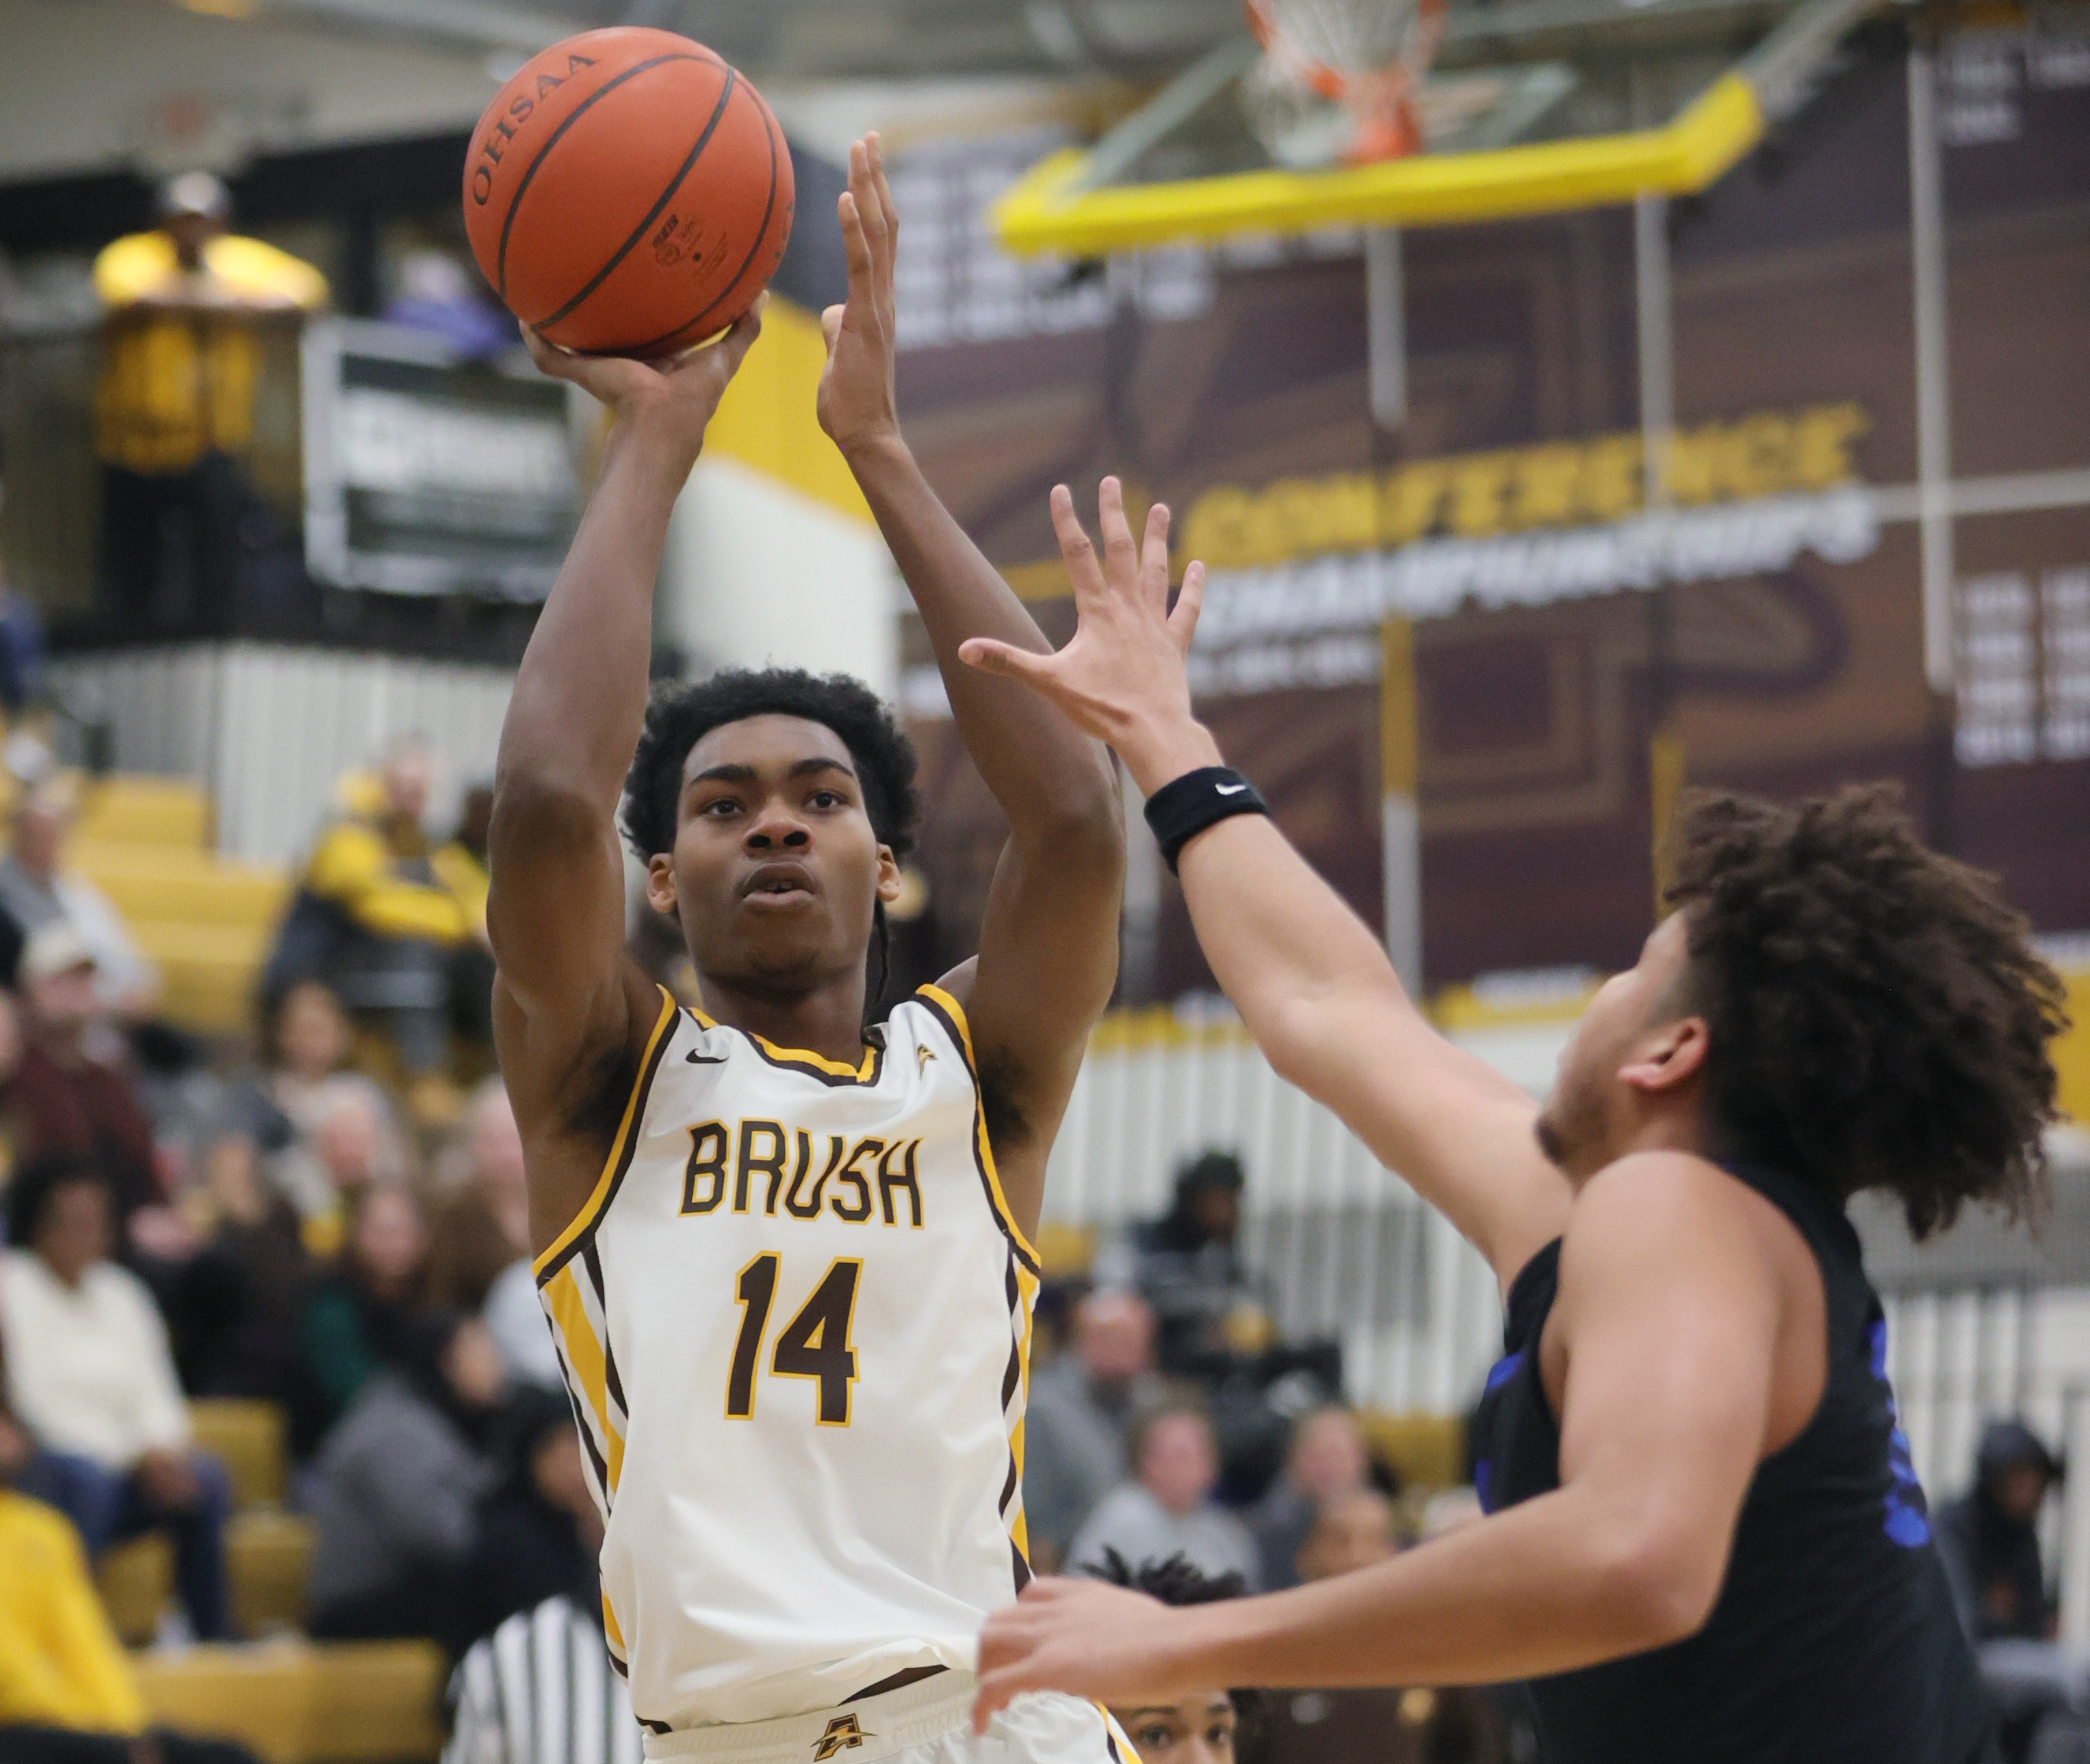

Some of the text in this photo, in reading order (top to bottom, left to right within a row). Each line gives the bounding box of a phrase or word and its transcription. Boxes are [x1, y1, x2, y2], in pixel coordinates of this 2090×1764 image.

[473, 53, 597, 206] OHSAA
[678, 1117, 925, 1230] BRUSH
[724, 1251, 864, 1427] 14
